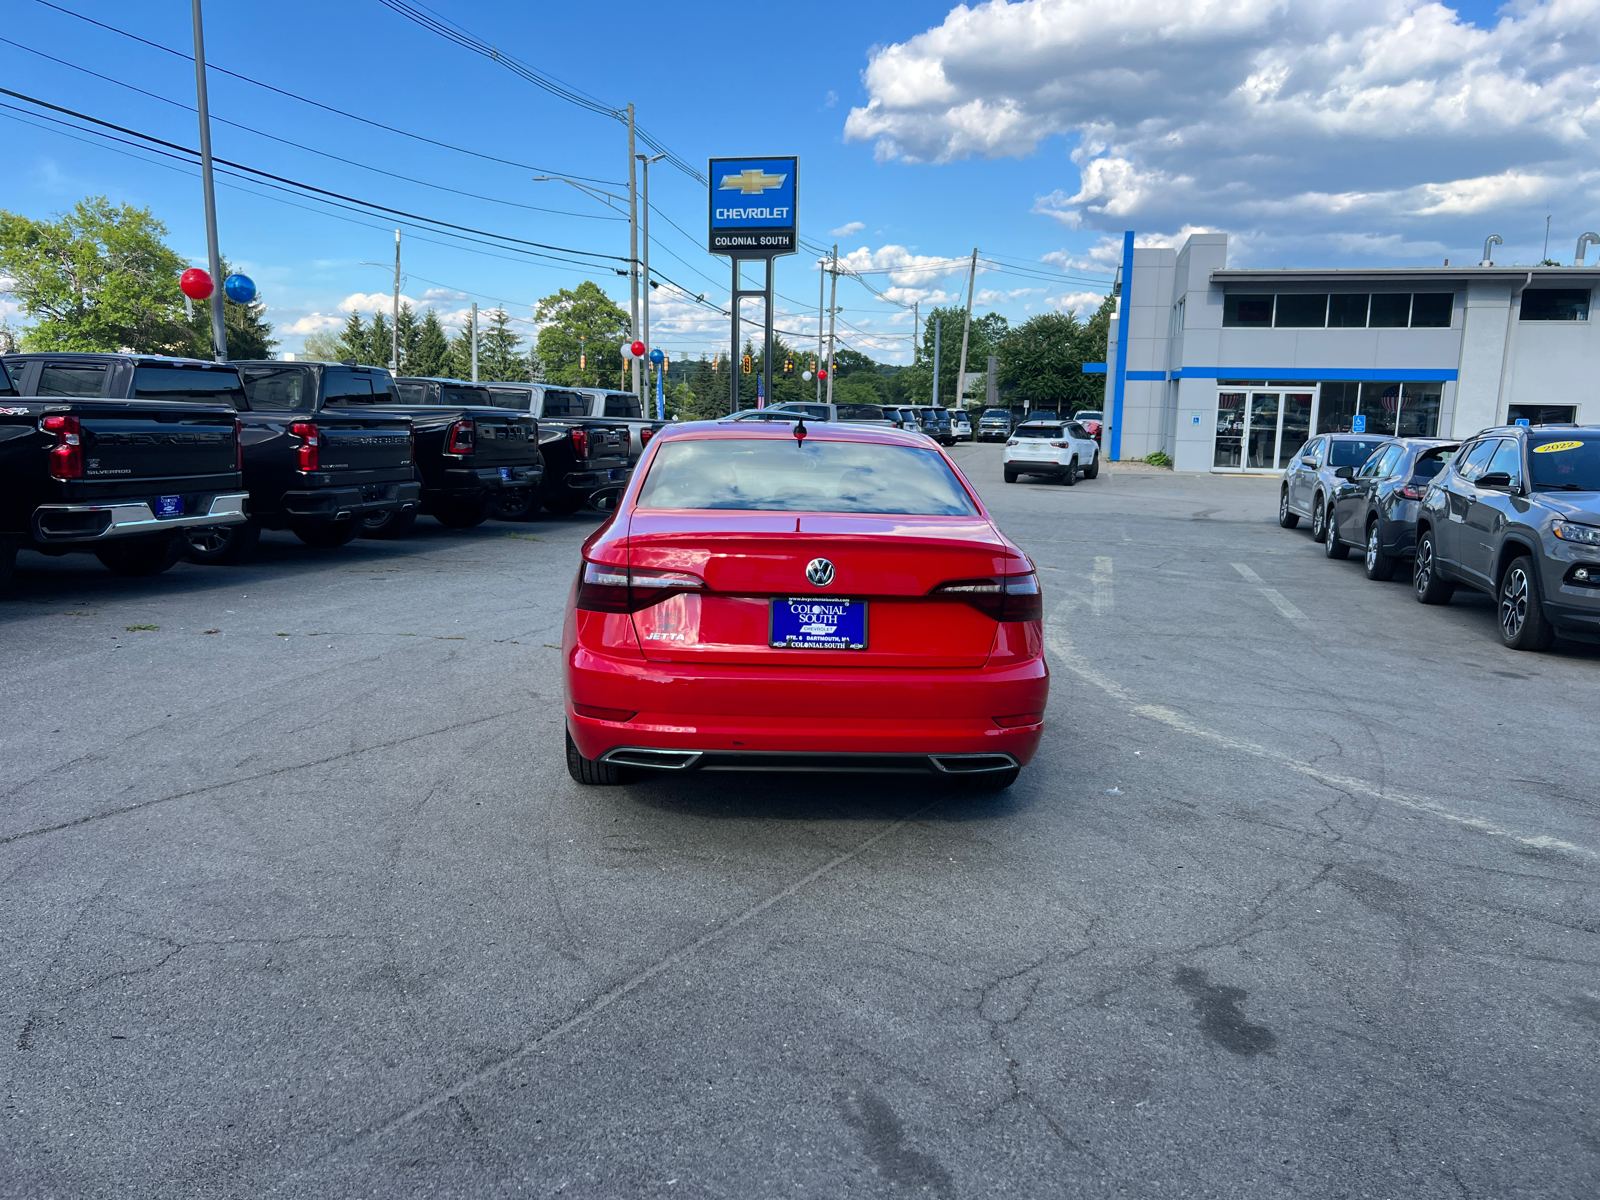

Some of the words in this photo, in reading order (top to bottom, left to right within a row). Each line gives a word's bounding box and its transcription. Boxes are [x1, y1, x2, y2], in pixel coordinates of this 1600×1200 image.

[716, 207, 789, 219] CHEVROLET
[715, 237, 757, 246] COLONIAL
[760, 236, 789, 245] SOUTH
[1543, 442, 1575, 452] 2022
[791, 604, 846, 615] COLONIAL
[799, 613, 838, 624] SOUTH
[645, 633, 685, 641] JETTA
